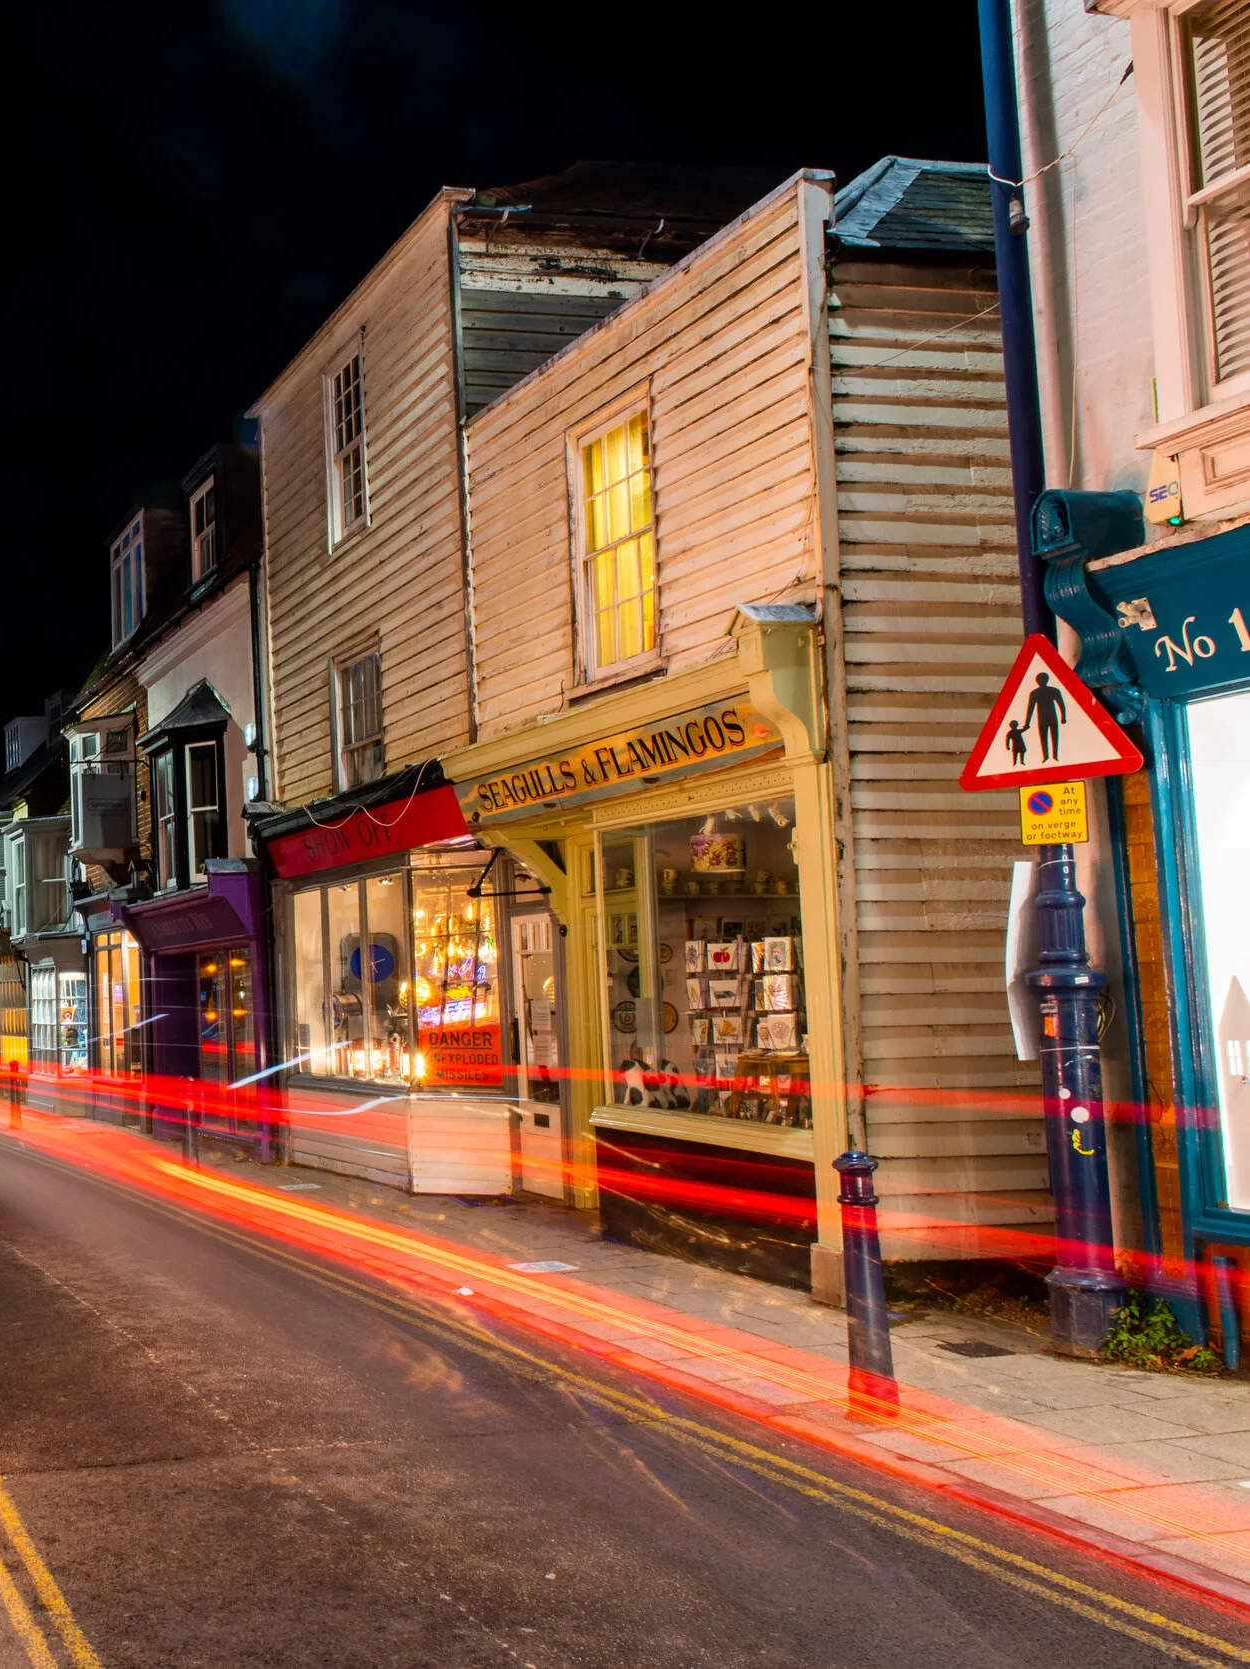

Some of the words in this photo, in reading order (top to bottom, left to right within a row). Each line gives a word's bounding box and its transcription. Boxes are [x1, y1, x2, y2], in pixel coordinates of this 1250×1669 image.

[1155, 616, 1216, 672] No
[477, 760, 577, 812] SEAGULLS
[581, 758, 598, 785] &
[594, 707, 746, 783] FLAMINGOS
[1063, 786, 1076, 795] At
[1060, 798, 1079, 807] any
[1058, 807, 1082, 816] time
[1031, 823, 1044, 831] on
[1047, 820, 1077, 831] verge
[302, 826, 352, 861] SHOW
[357, 812, 391, 847] OFF
[1026, 833, 1038, 841] or
[1040, 830, 1083, 841] footway
[429, 1031, 493, 1047] DANGER
[430, 1053, 499, 1066] NEXPLODED
[436, 1068, 490, 1082] MISSILES
